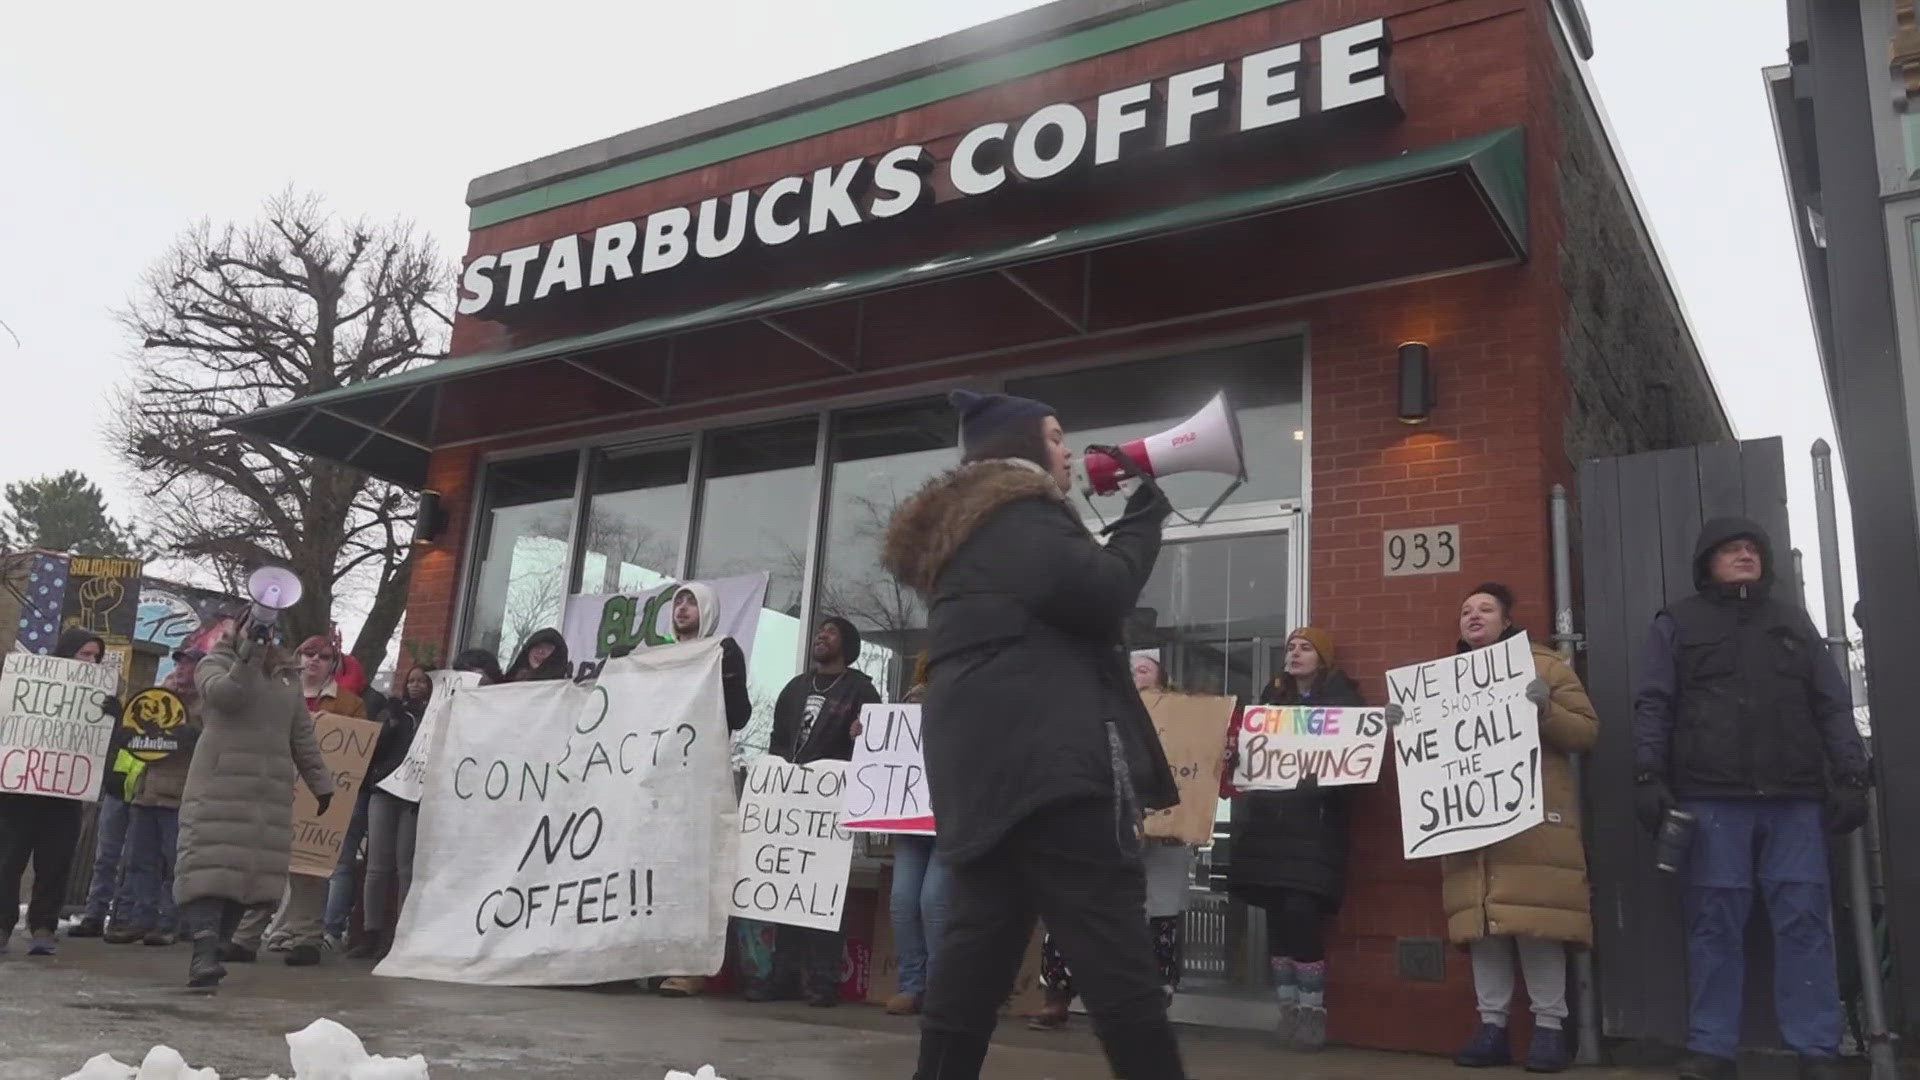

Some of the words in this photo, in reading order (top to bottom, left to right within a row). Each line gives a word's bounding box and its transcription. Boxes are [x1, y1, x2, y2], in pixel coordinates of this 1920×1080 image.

[457, 143, 923, 316] STARBUCKS
[949, 17, 1388, 196] COFFEE
[1388, 531, 1455, 571] 933
[1389, 663, 1440, 705] WE
[1455, 643, 1523, 694] PULL
[12, 677, 107, 723] RIGHTS
[1243, 707, 1344, 735] CHANGE
[1356, 712, 1383, 736] IS
[0, 714, 22, 746] OT
[1397, 728, 1439, 767] WE
[1454, 704, 1522, 752] CALL
[1, 748, 91, 796] GREED
[849, 764, 933, 817] STR
[1420, 747, 1538, 833] SHOTS!
[1441, 753, 1483, 780] THE
[517, 806, 604, 873] NO
[755, 844, 817, 874] GET
[475, 869, 654, 935] COFFEE!!
[731, 877, 839, 916] COAL!
